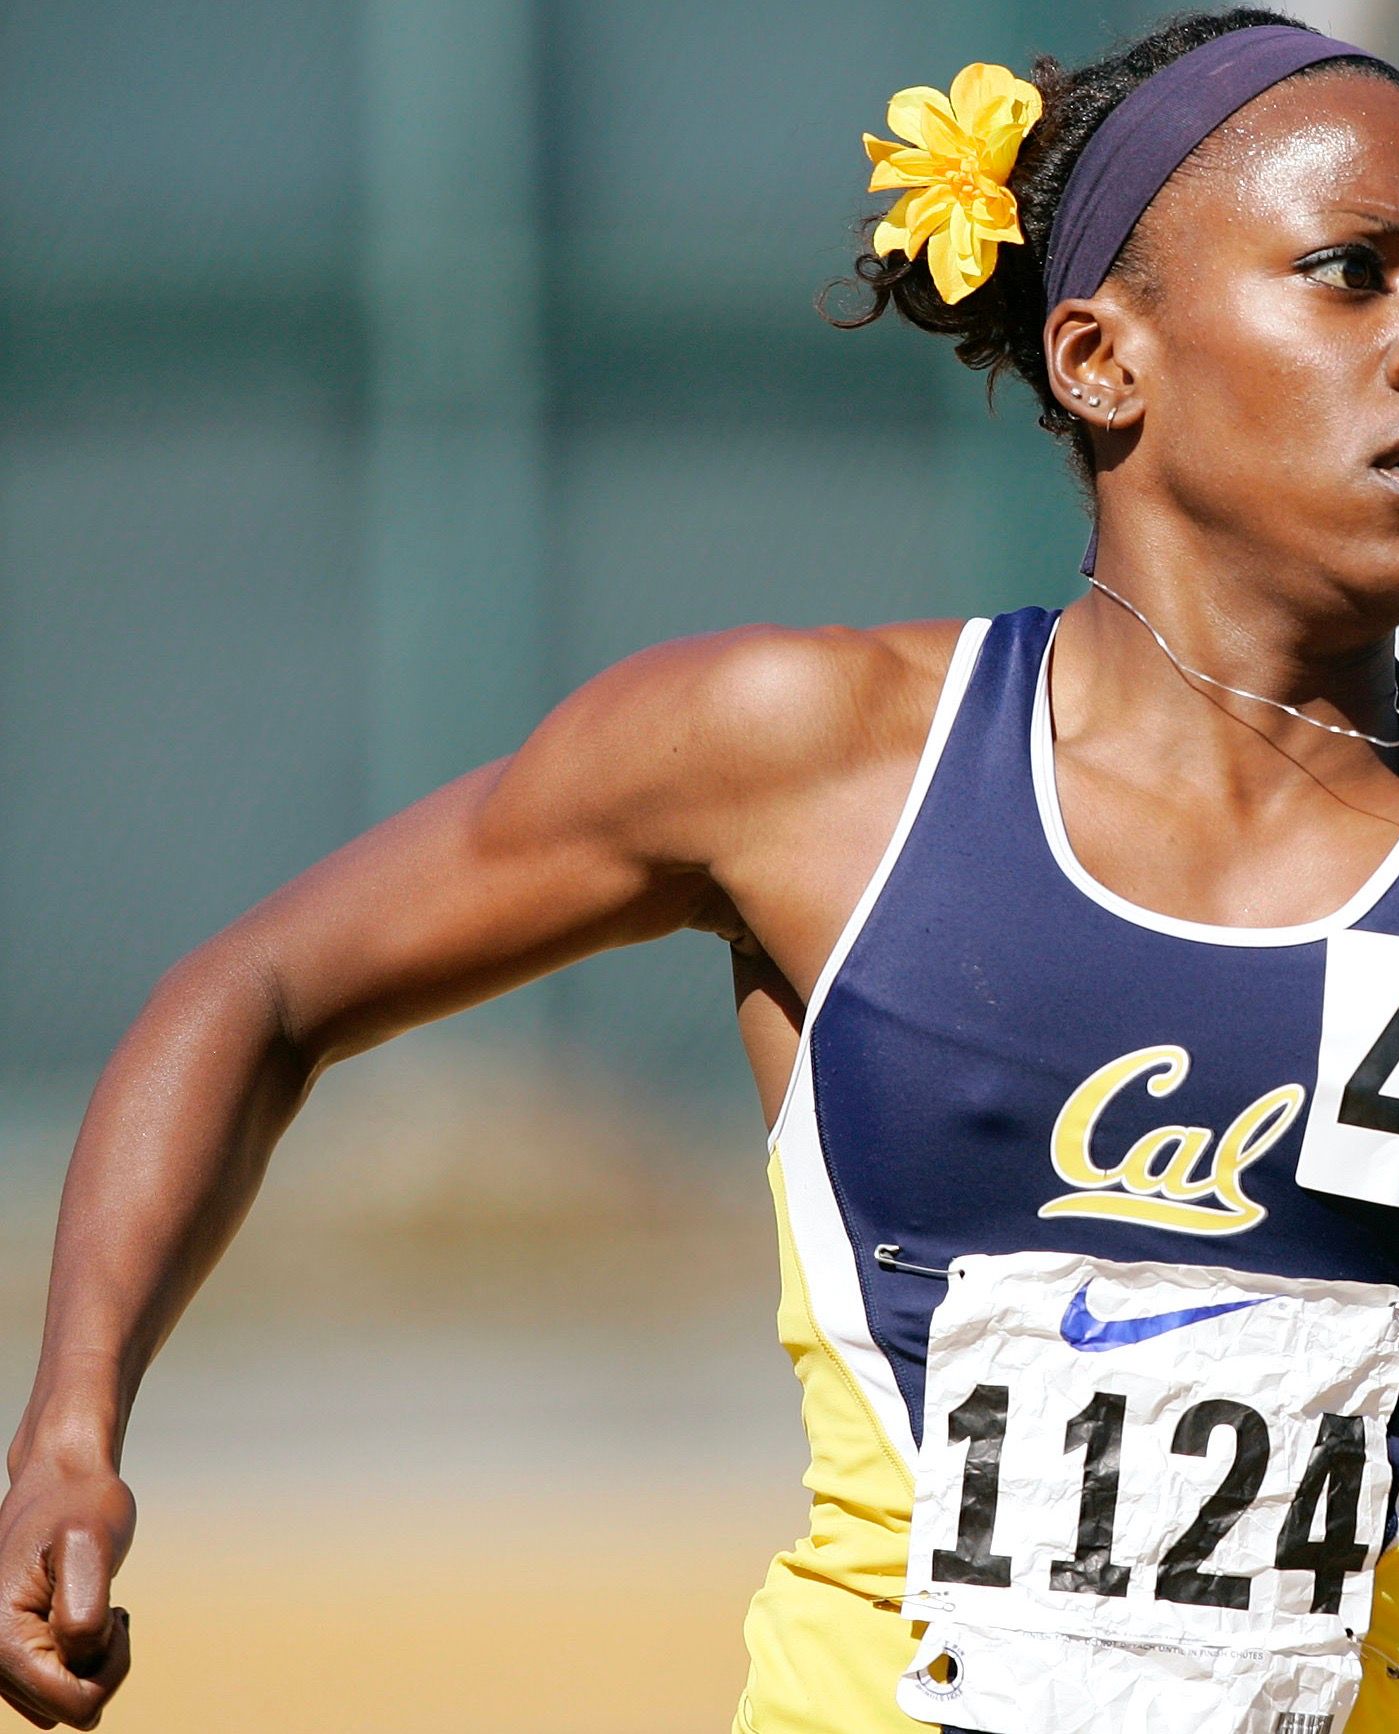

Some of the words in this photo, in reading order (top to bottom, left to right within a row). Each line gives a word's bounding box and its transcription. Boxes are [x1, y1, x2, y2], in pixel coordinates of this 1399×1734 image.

[1038, 1044, 1306, 1237] Cal
[931, 1384, 1370, 1615] 1124
[1158, 1644, 1185, 1656] UNTIL
[1230, 1650, 1264, 1660] CHUTES
